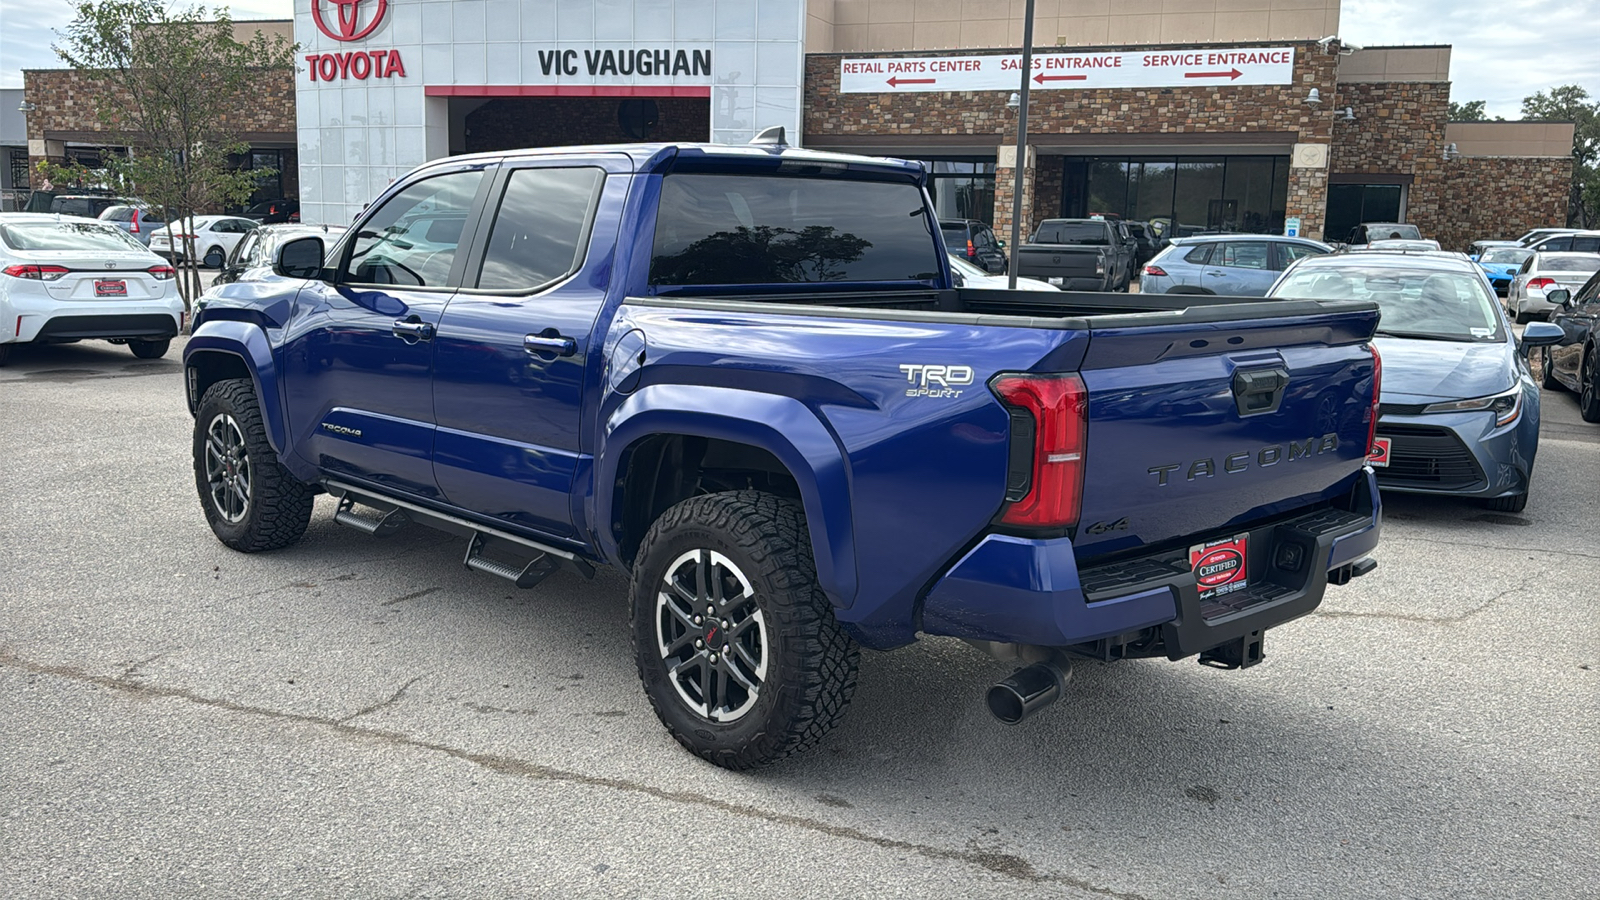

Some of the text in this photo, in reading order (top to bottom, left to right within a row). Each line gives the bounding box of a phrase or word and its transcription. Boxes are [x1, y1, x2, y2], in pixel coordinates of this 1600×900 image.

[305, 50, 407, 82] TOYOTA
[538, 49, 711, 76] VIC VAUGHAN
[843, 60, 981, 74] RETAIL PARTS CENTER
[1046, 56, 1122, 69] ENTRANCE
[1143, 52, 1290, 67] SERVICE ENTRANCE
[899, 364, 974, 387] TRD
[905, 387, 963, 398] SPORT
[321, 422, 362, 436] TACOMA
[1148, 433, 1339, 487] TACOMA
[1199, 560, 1237, 577] CERTIFIED
